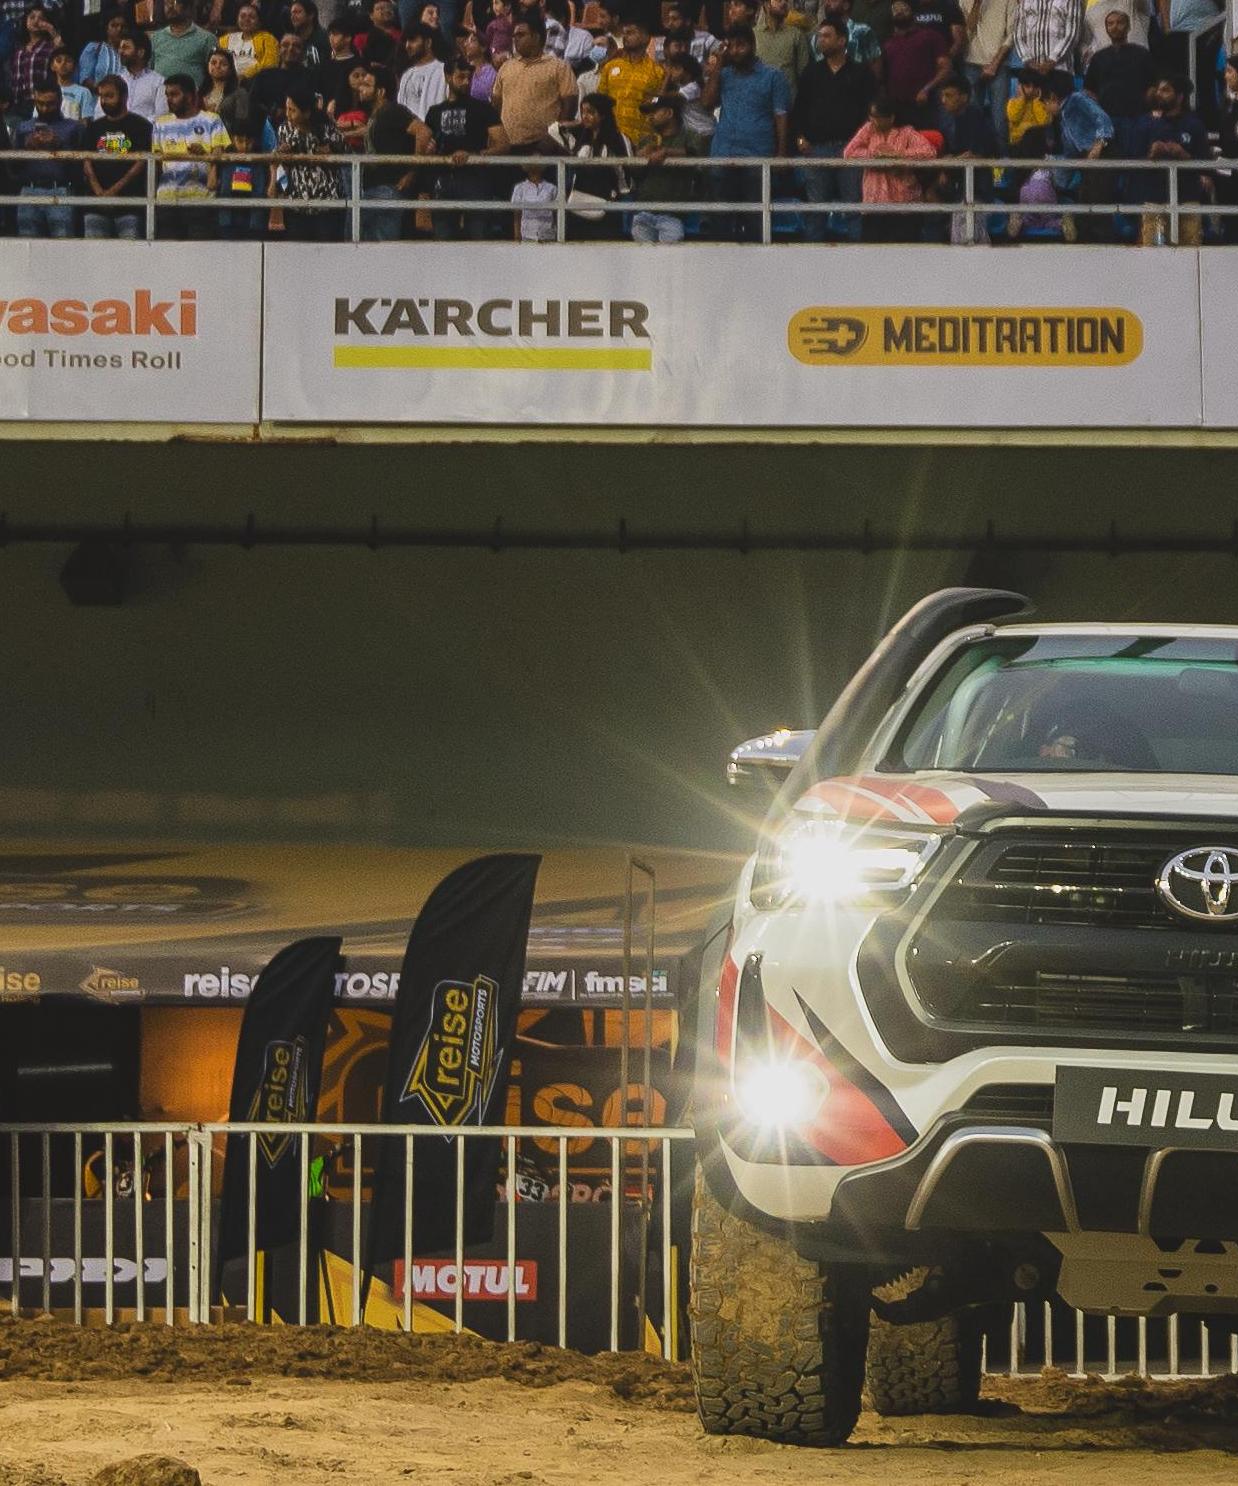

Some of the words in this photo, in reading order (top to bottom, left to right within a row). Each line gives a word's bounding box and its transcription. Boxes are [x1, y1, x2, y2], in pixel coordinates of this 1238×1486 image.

[0, 289, 197, 336] asaki
[334, 297, 650, 338] KÄRCHER
[883, 315, 1126, 354] MEDITRATION
[0, 350, 36, 368] od
[43, 350, 123, 368] Times
[131, 351, 182, 370] Roll
[0, 966, 41, 992] ise
[436, 989, 469, 1086] reise
[403, 1264, 530, 1294] MOTUL
